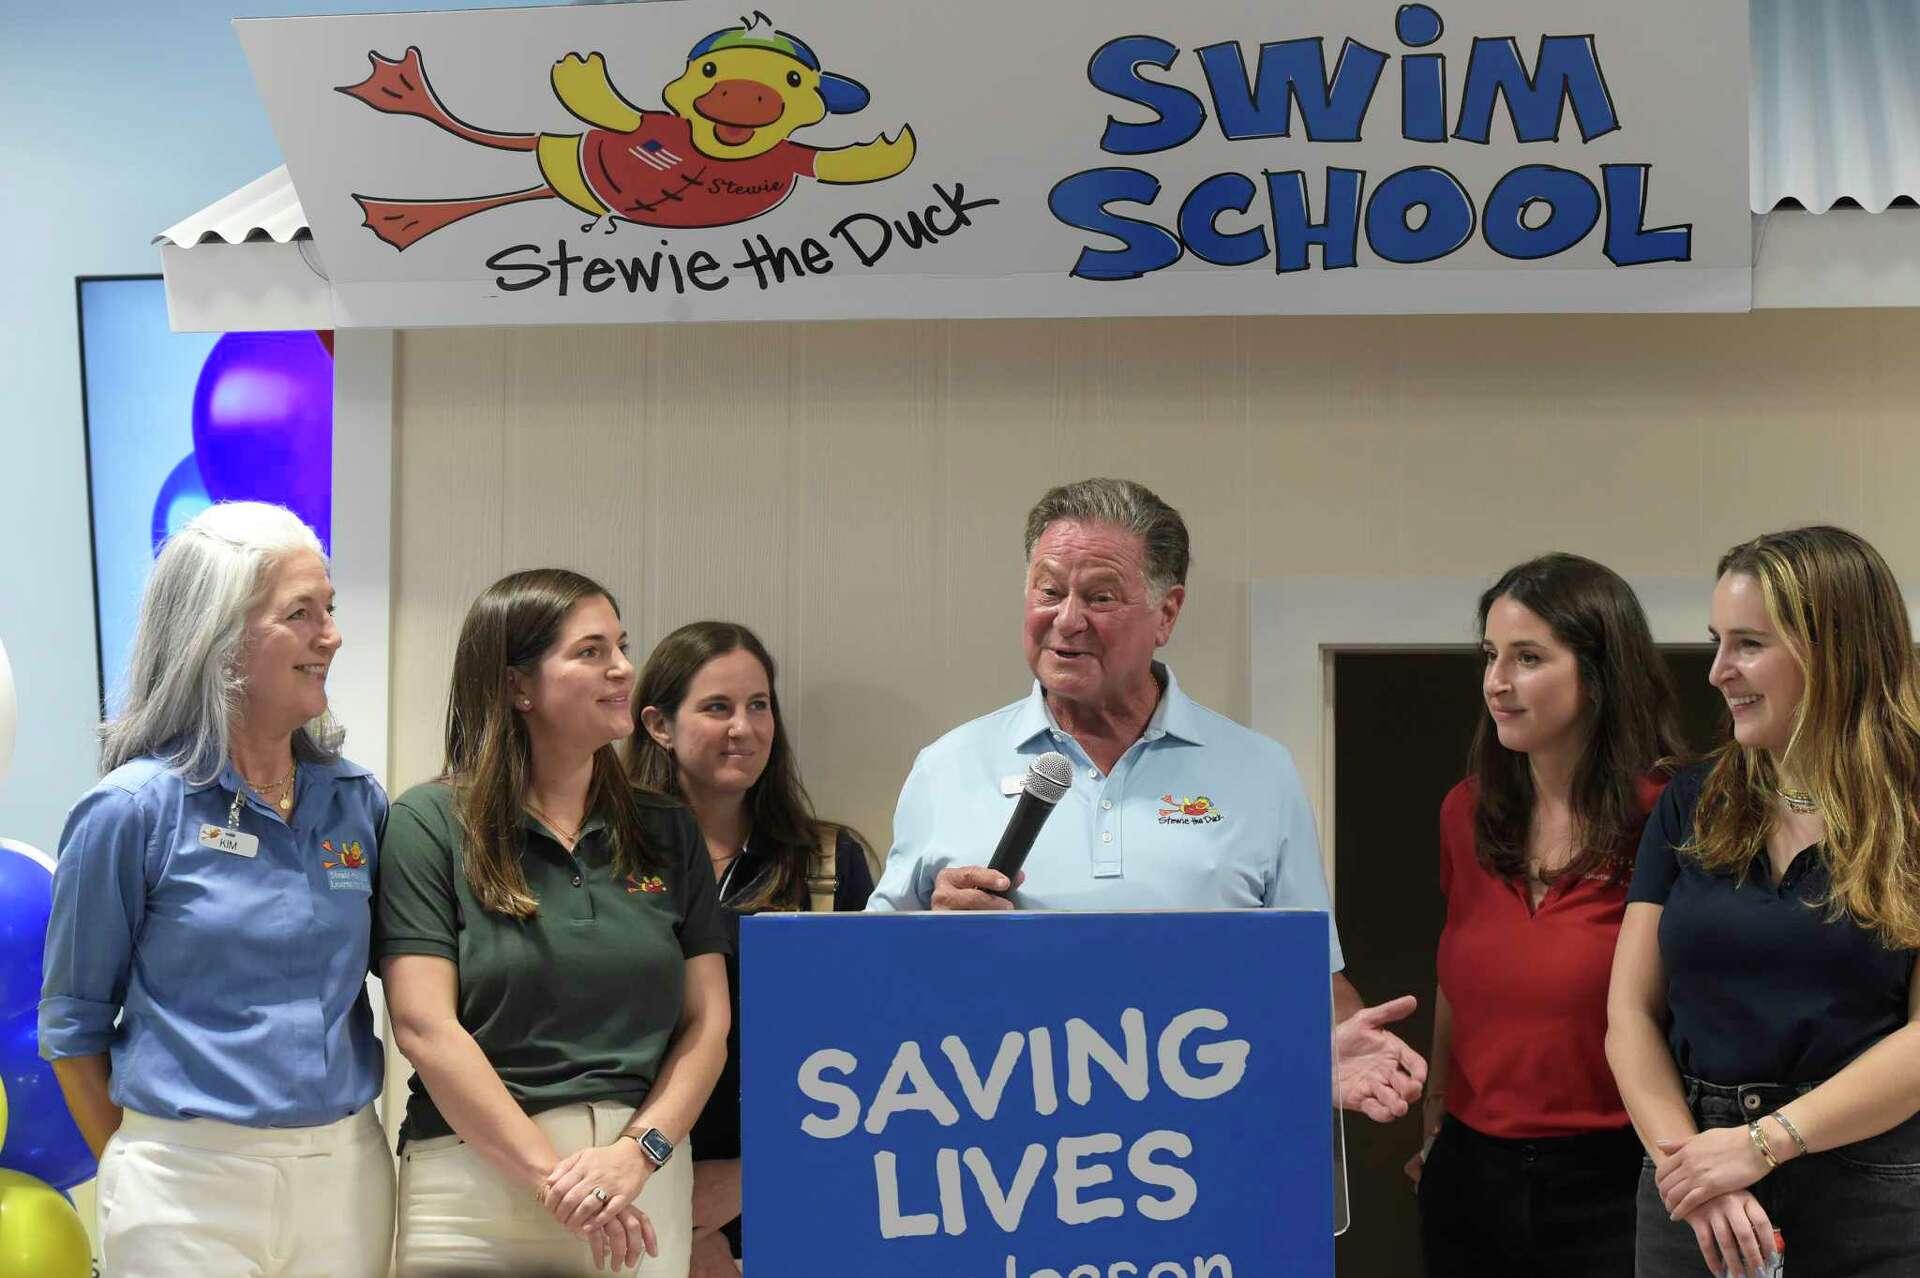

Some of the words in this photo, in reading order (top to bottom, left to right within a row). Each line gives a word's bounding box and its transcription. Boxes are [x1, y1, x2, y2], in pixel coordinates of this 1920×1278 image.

[485, 239, 729, 296] Stewie
[733, 233, 834, 289] the
[829, 182, 1000, 266] Duck
[707, 177, 784, 194] Stewie
[1047, 164, 1692, 281] SCHOOL
[219, 838, 238, 850] KIM
[797, 1007, 1251, 1139] SAVING
[874, 1130, 1198, 1239] LIVES
